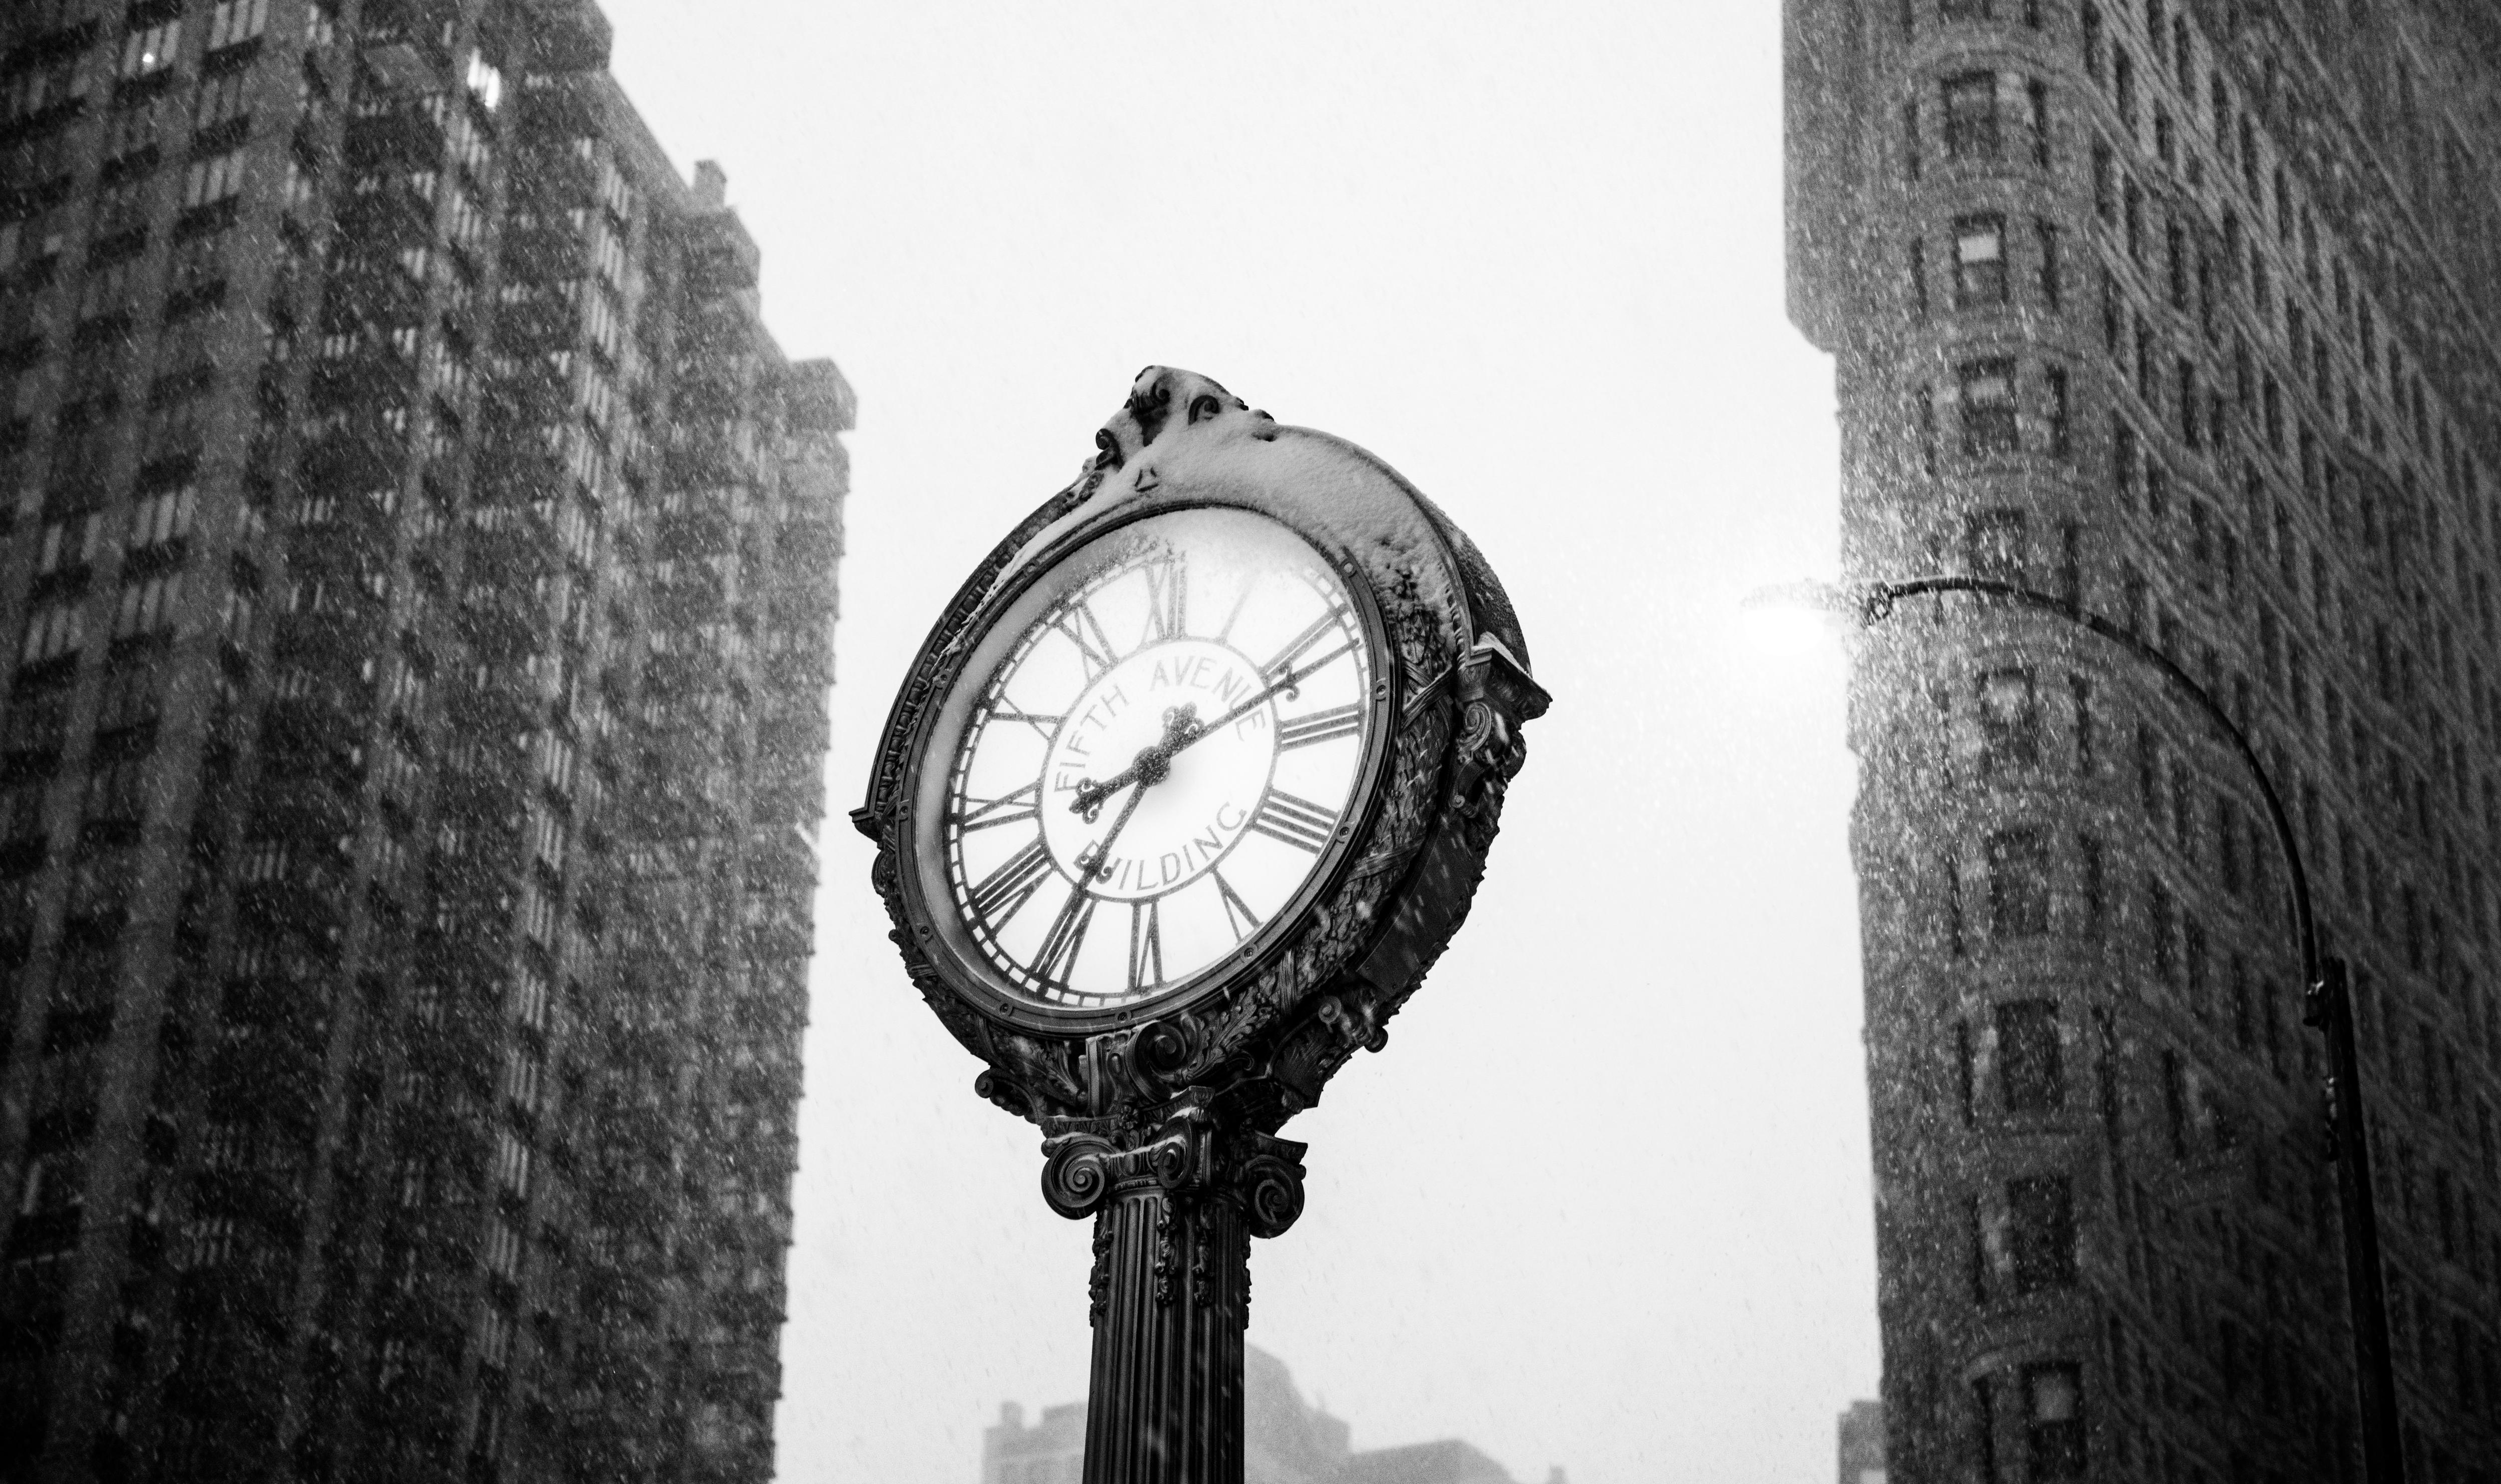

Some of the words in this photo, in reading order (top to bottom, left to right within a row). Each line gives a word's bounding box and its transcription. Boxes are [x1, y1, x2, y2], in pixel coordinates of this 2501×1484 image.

[1051, 598, 1120, 688] XI
[1137, 553, 1188, 650] XII
[1257, 602, 1350, 687] II
[983, 689, 1068, 742] X
[1053, 683, 1130, 793] FIFTH
[1276, 698, 1366, 757] III
[961, 777, 1041, 837] IX
[1249, 784, 1342, 857] IIII
[968, 833, 1057, 941] VIII
[1208, 864, 1264, 947] V
[1026, 882, 1100, 991] VII
[1124, 898, 1167, 993] VI
